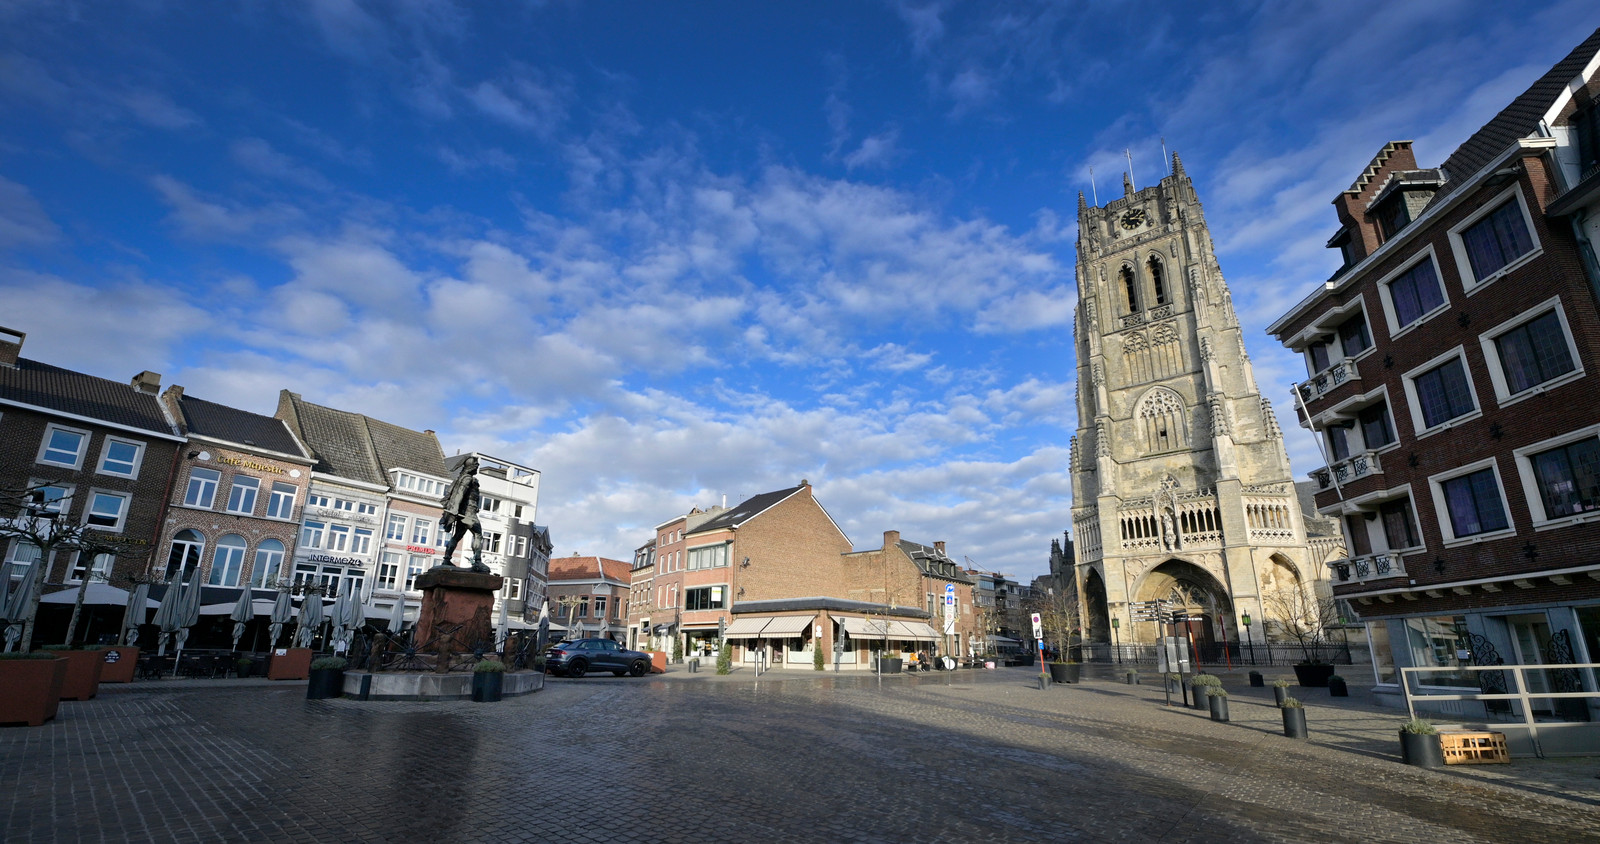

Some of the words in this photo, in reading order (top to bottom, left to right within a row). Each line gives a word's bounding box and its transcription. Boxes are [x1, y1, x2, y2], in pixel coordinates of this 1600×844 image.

[217, 455, 241, 466] Café
[242, 460, 284, 475] Majestic
[406, 544, 436, 555] PRIMUS
